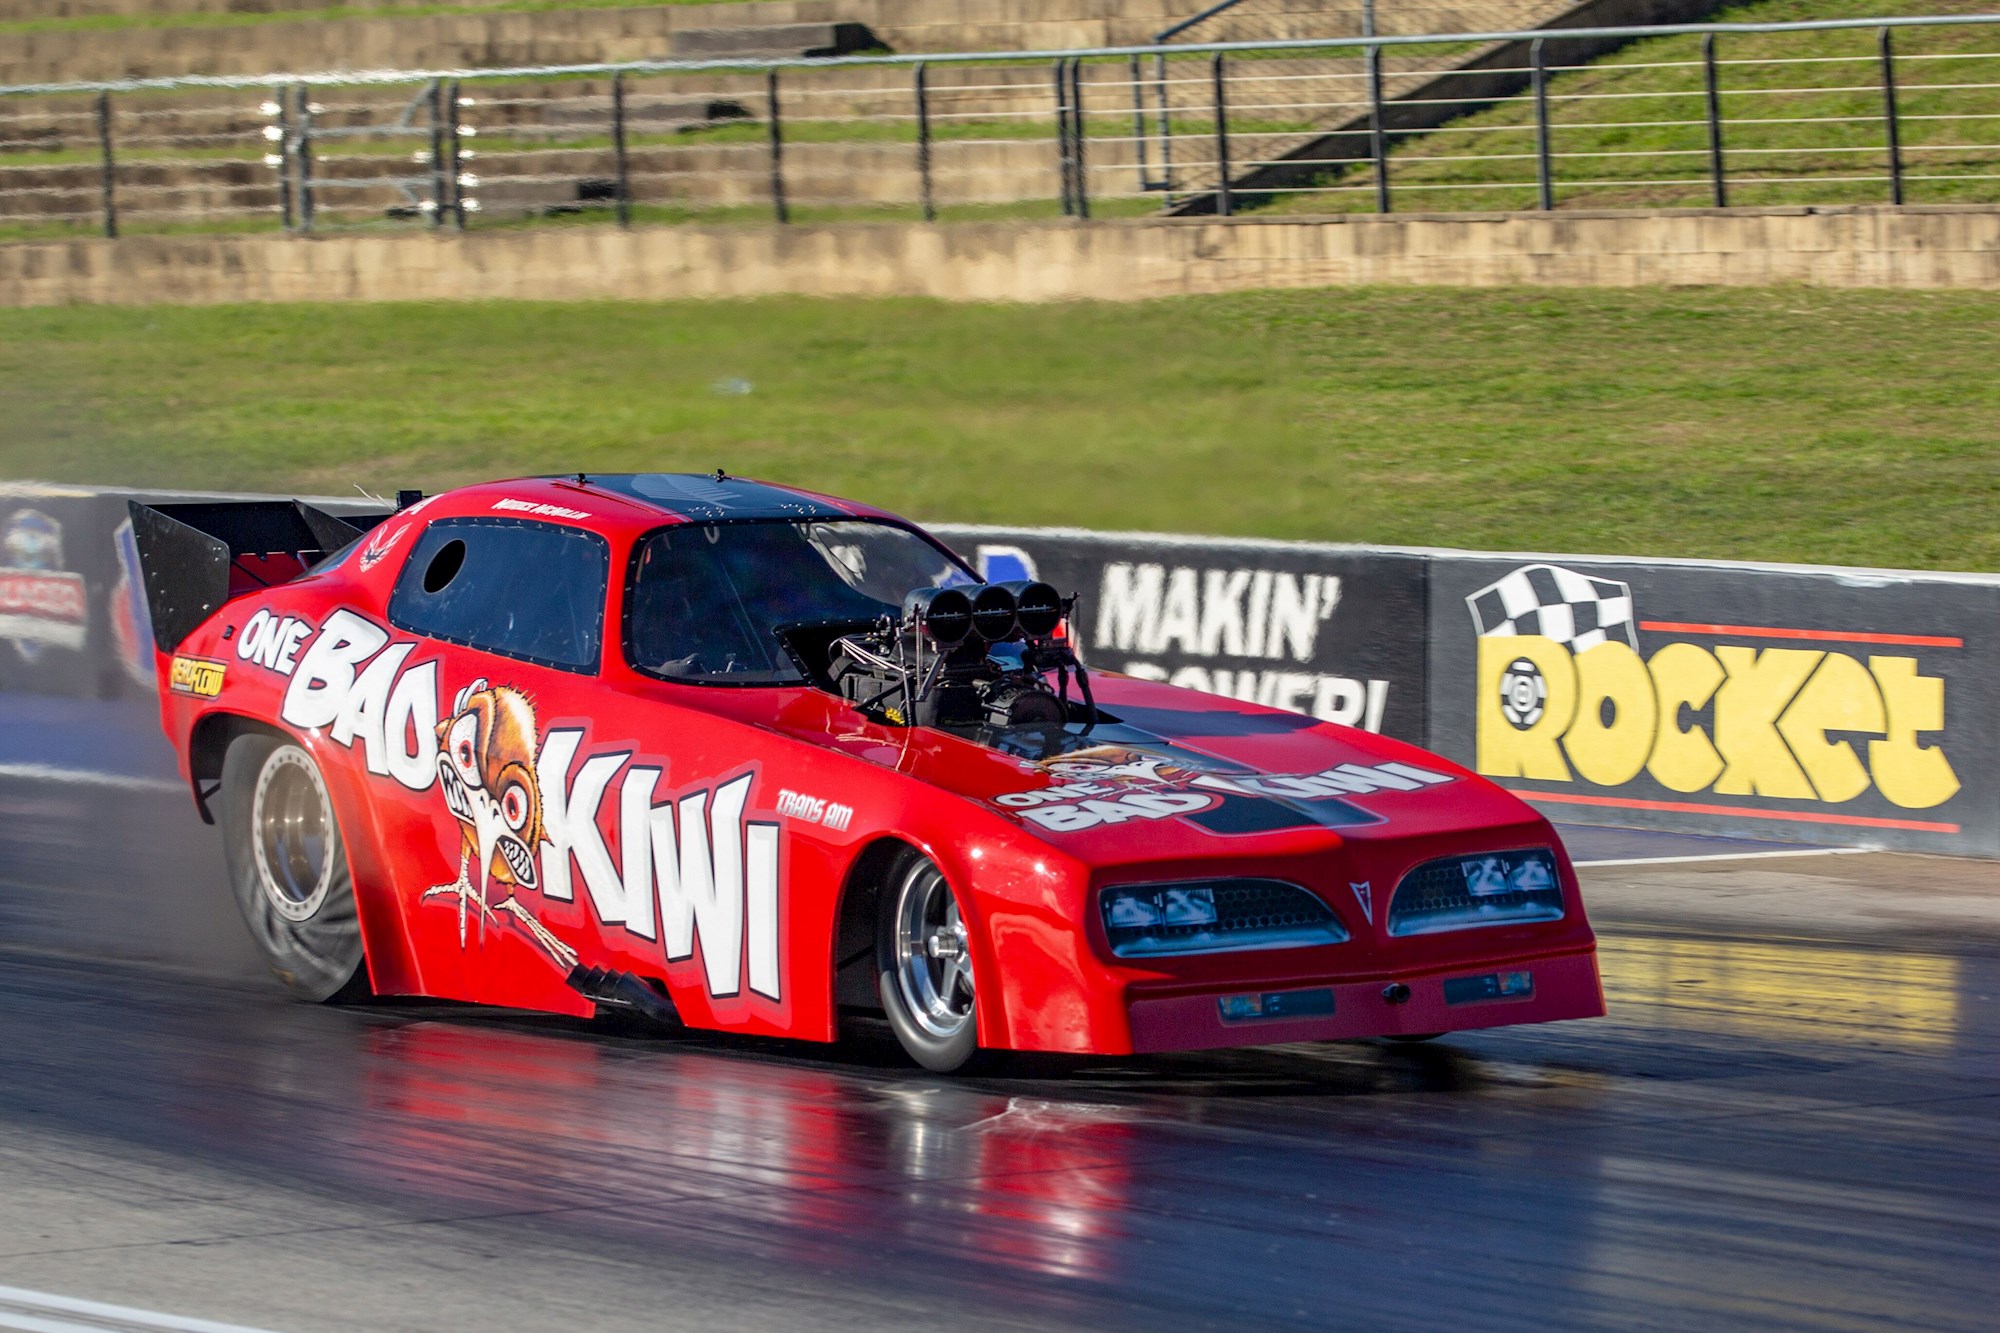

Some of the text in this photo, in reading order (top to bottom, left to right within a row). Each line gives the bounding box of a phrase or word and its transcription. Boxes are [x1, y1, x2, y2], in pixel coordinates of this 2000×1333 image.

[1095, 561, 1342, 663] MAKIN'
[237, 607, 781, 1003] ONE BAD KIWI
[776, 788, 854, 832] TRANS AM
[995, 781, 1213, 832] ONE BAD
